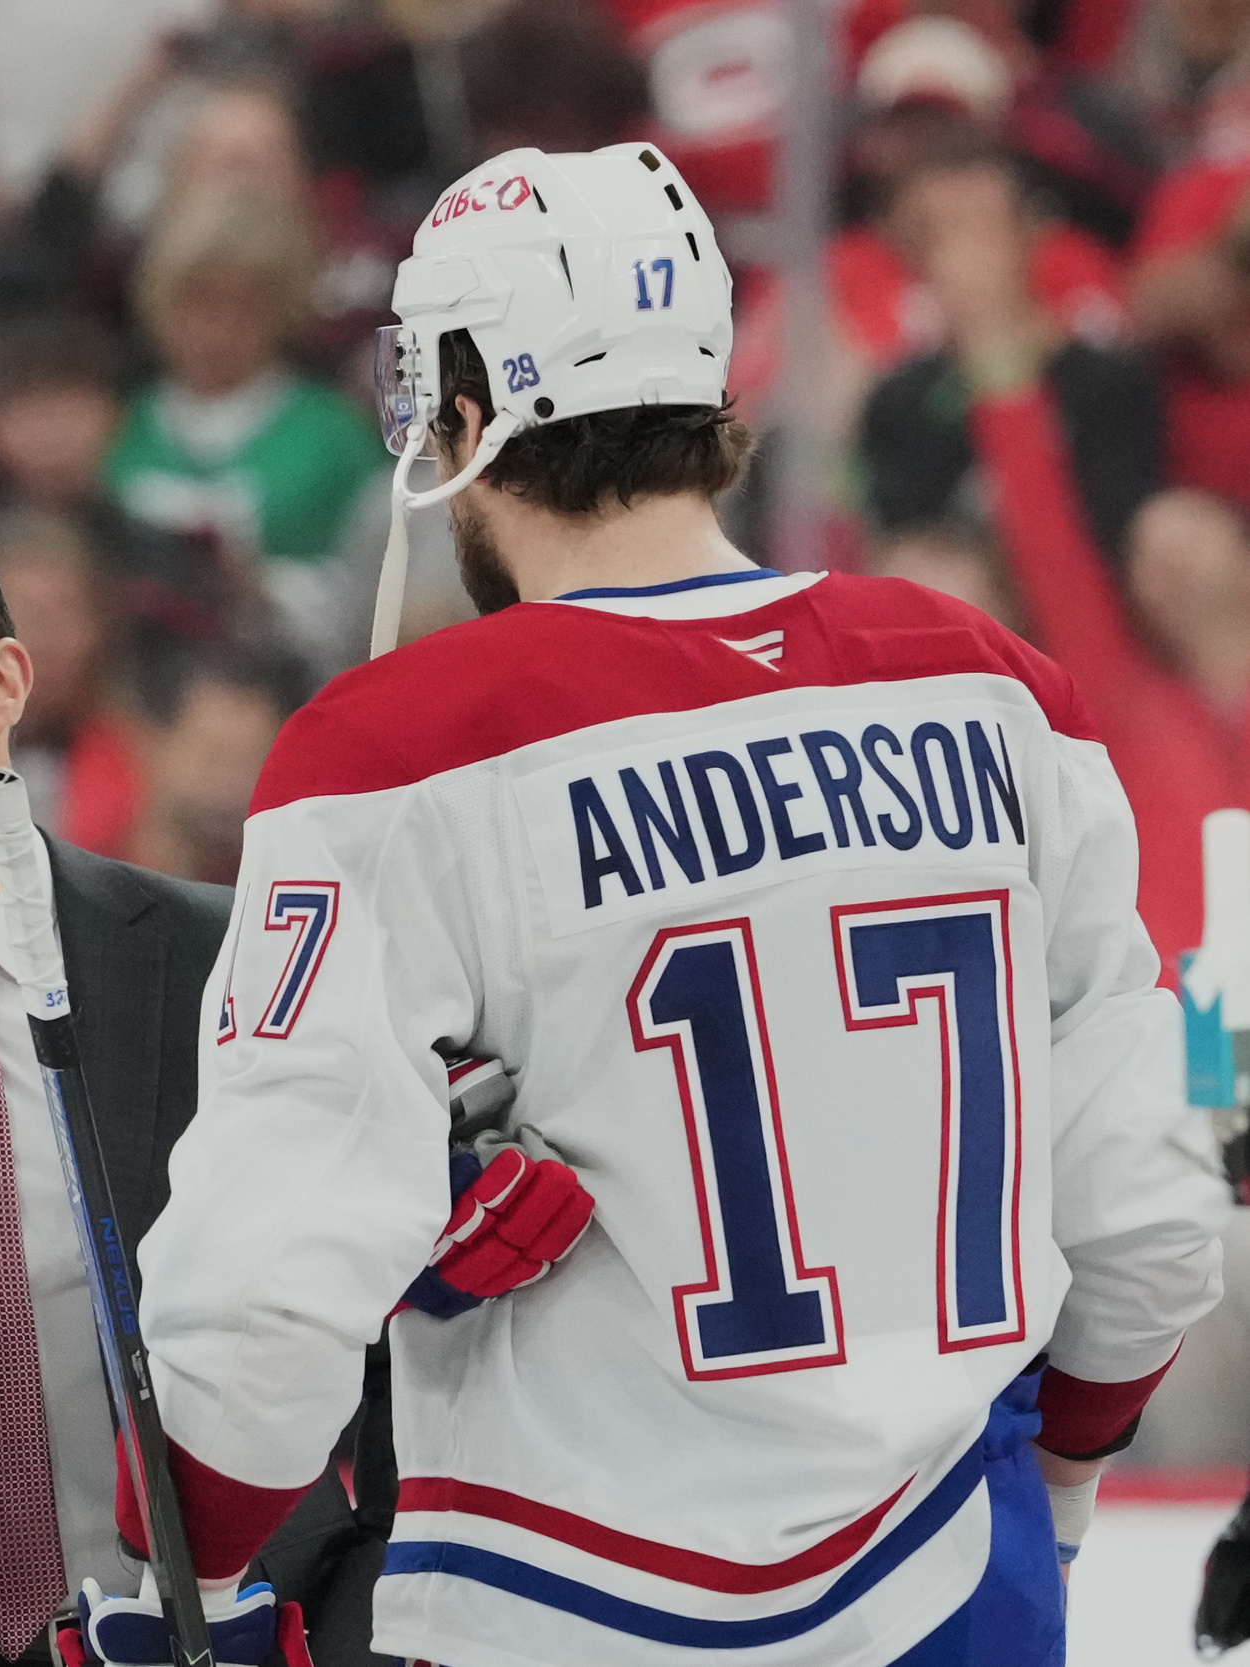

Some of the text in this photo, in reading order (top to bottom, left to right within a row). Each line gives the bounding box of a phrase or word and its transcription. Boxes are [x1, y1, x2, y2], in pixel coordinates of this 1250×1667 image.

[431, 180, 495, 228] CIBC
[632, 256, 676, 312] 17
[502, 352, 542, 393] 29
[567, 719, 1026, 910] ANDERSON
[625, 888, 1026, 1382] 17
